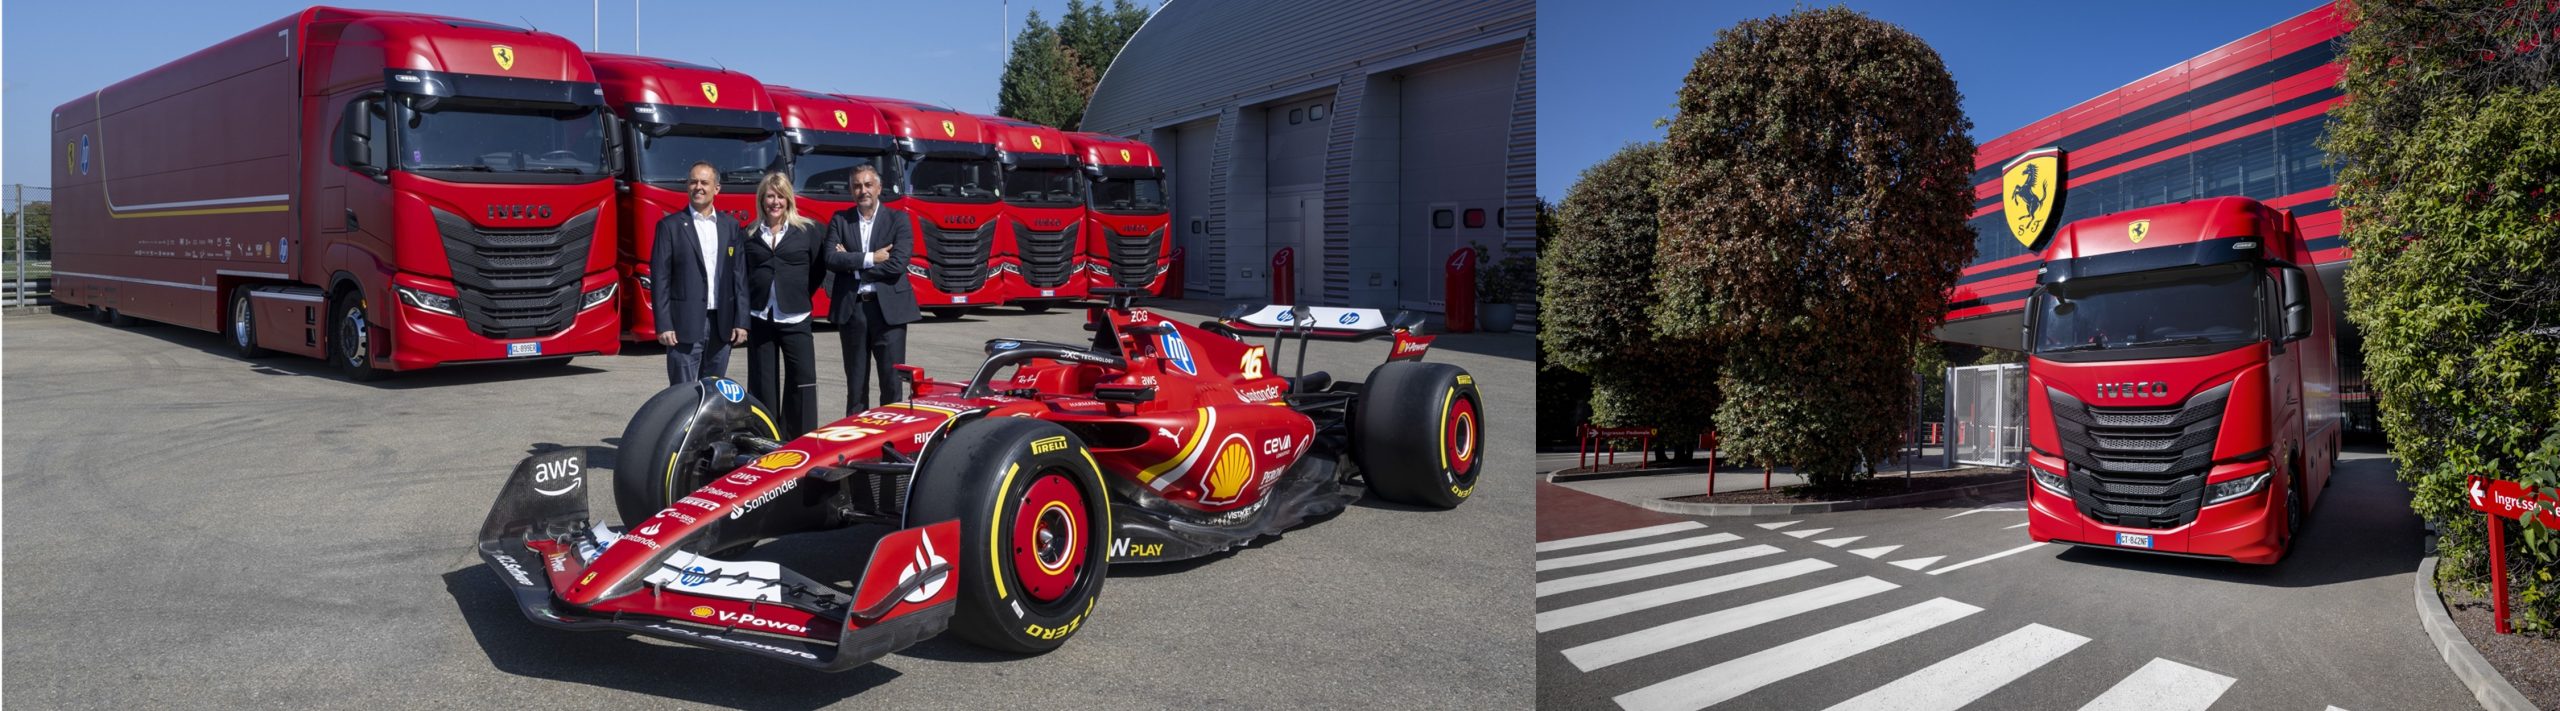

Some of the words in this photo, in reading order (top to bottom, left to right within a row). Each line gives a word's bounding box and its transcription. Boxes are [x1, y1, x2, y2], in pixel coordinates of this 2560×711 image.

[487, 203, 552, 219] IVECO
[1276, 249, 1289, 265] 3
[1451, 250, 1469, 270] 4
[1164, 326, 1195, 375] hp
[1080, 354, 1115, 365] TECHNOLOGY
[1240, 347, 1265, 380] 16
[1141, 376, 1157, 385] aws
[719, 380, 741, 402] hp
[2097, 381, 2168, 398] IVECO
[852, 417, 895, 426] PLAY
[856, 410, 927, 424] VGW
[803, 425, 886, 442] 16
[1031, 435, 1067, 455] PIRELLI
[535, 456, 579, 483] aws
[731, 472, 762, 483] aws
[706, 487, 738, 499] Palantir
[744, 477, 798, 513] Santander
[668, 511, 697, 524] CELSIUS
[623, 533, 662, 550] antander
[1130, 543, 1163, 557] PLAY
[718, 609, 811, 633] V-Power
[1026, 614, 1082, 640] ZERO
[701, 633, 819, 661] Software
